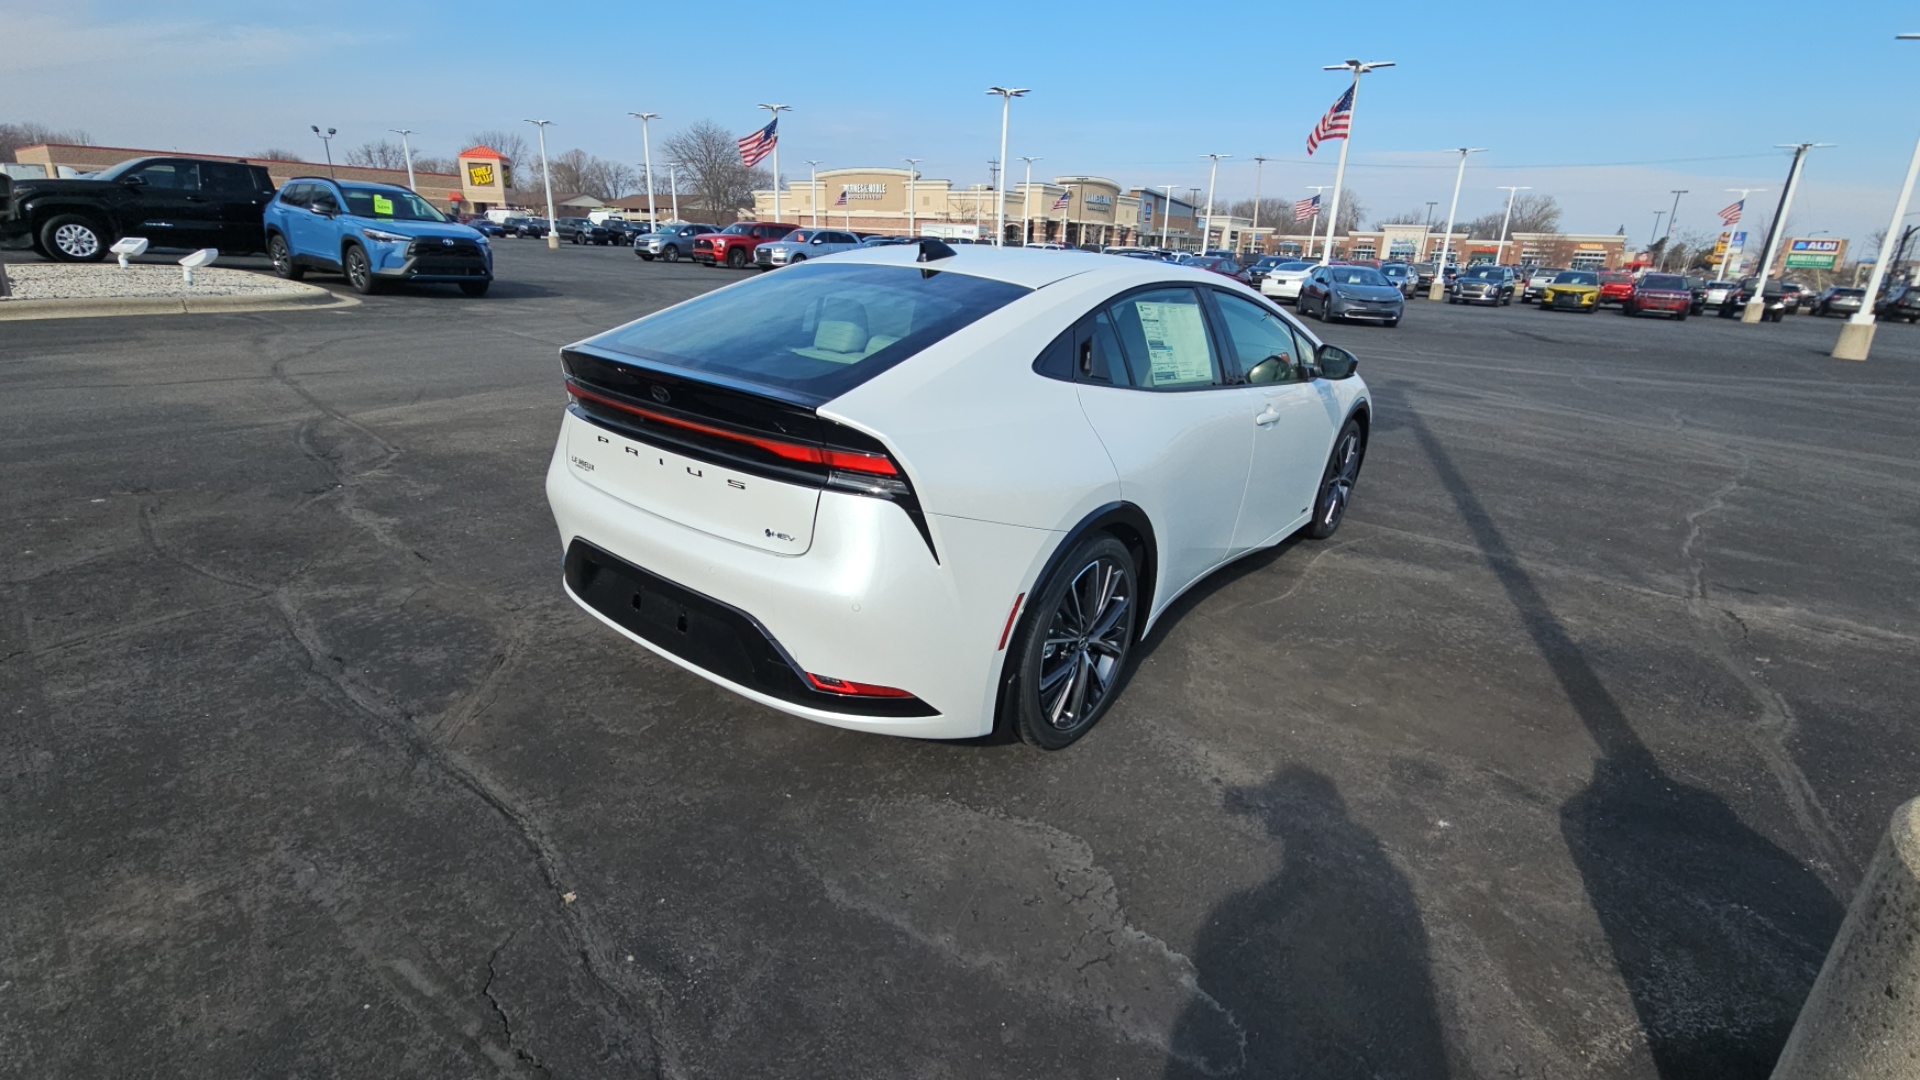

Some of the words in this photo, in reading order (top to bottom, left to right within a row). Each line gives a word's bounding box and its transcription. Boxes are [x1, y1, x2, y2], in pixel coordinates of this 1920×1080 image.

[470, 165, 491, 177] TIRES
[474, 173, 494, 186] PLUS
[1807, 241, 1837, 250] ALDI
[597, 435, 746, 490] PRIUS
[771, 531, 796, 541] HEV
